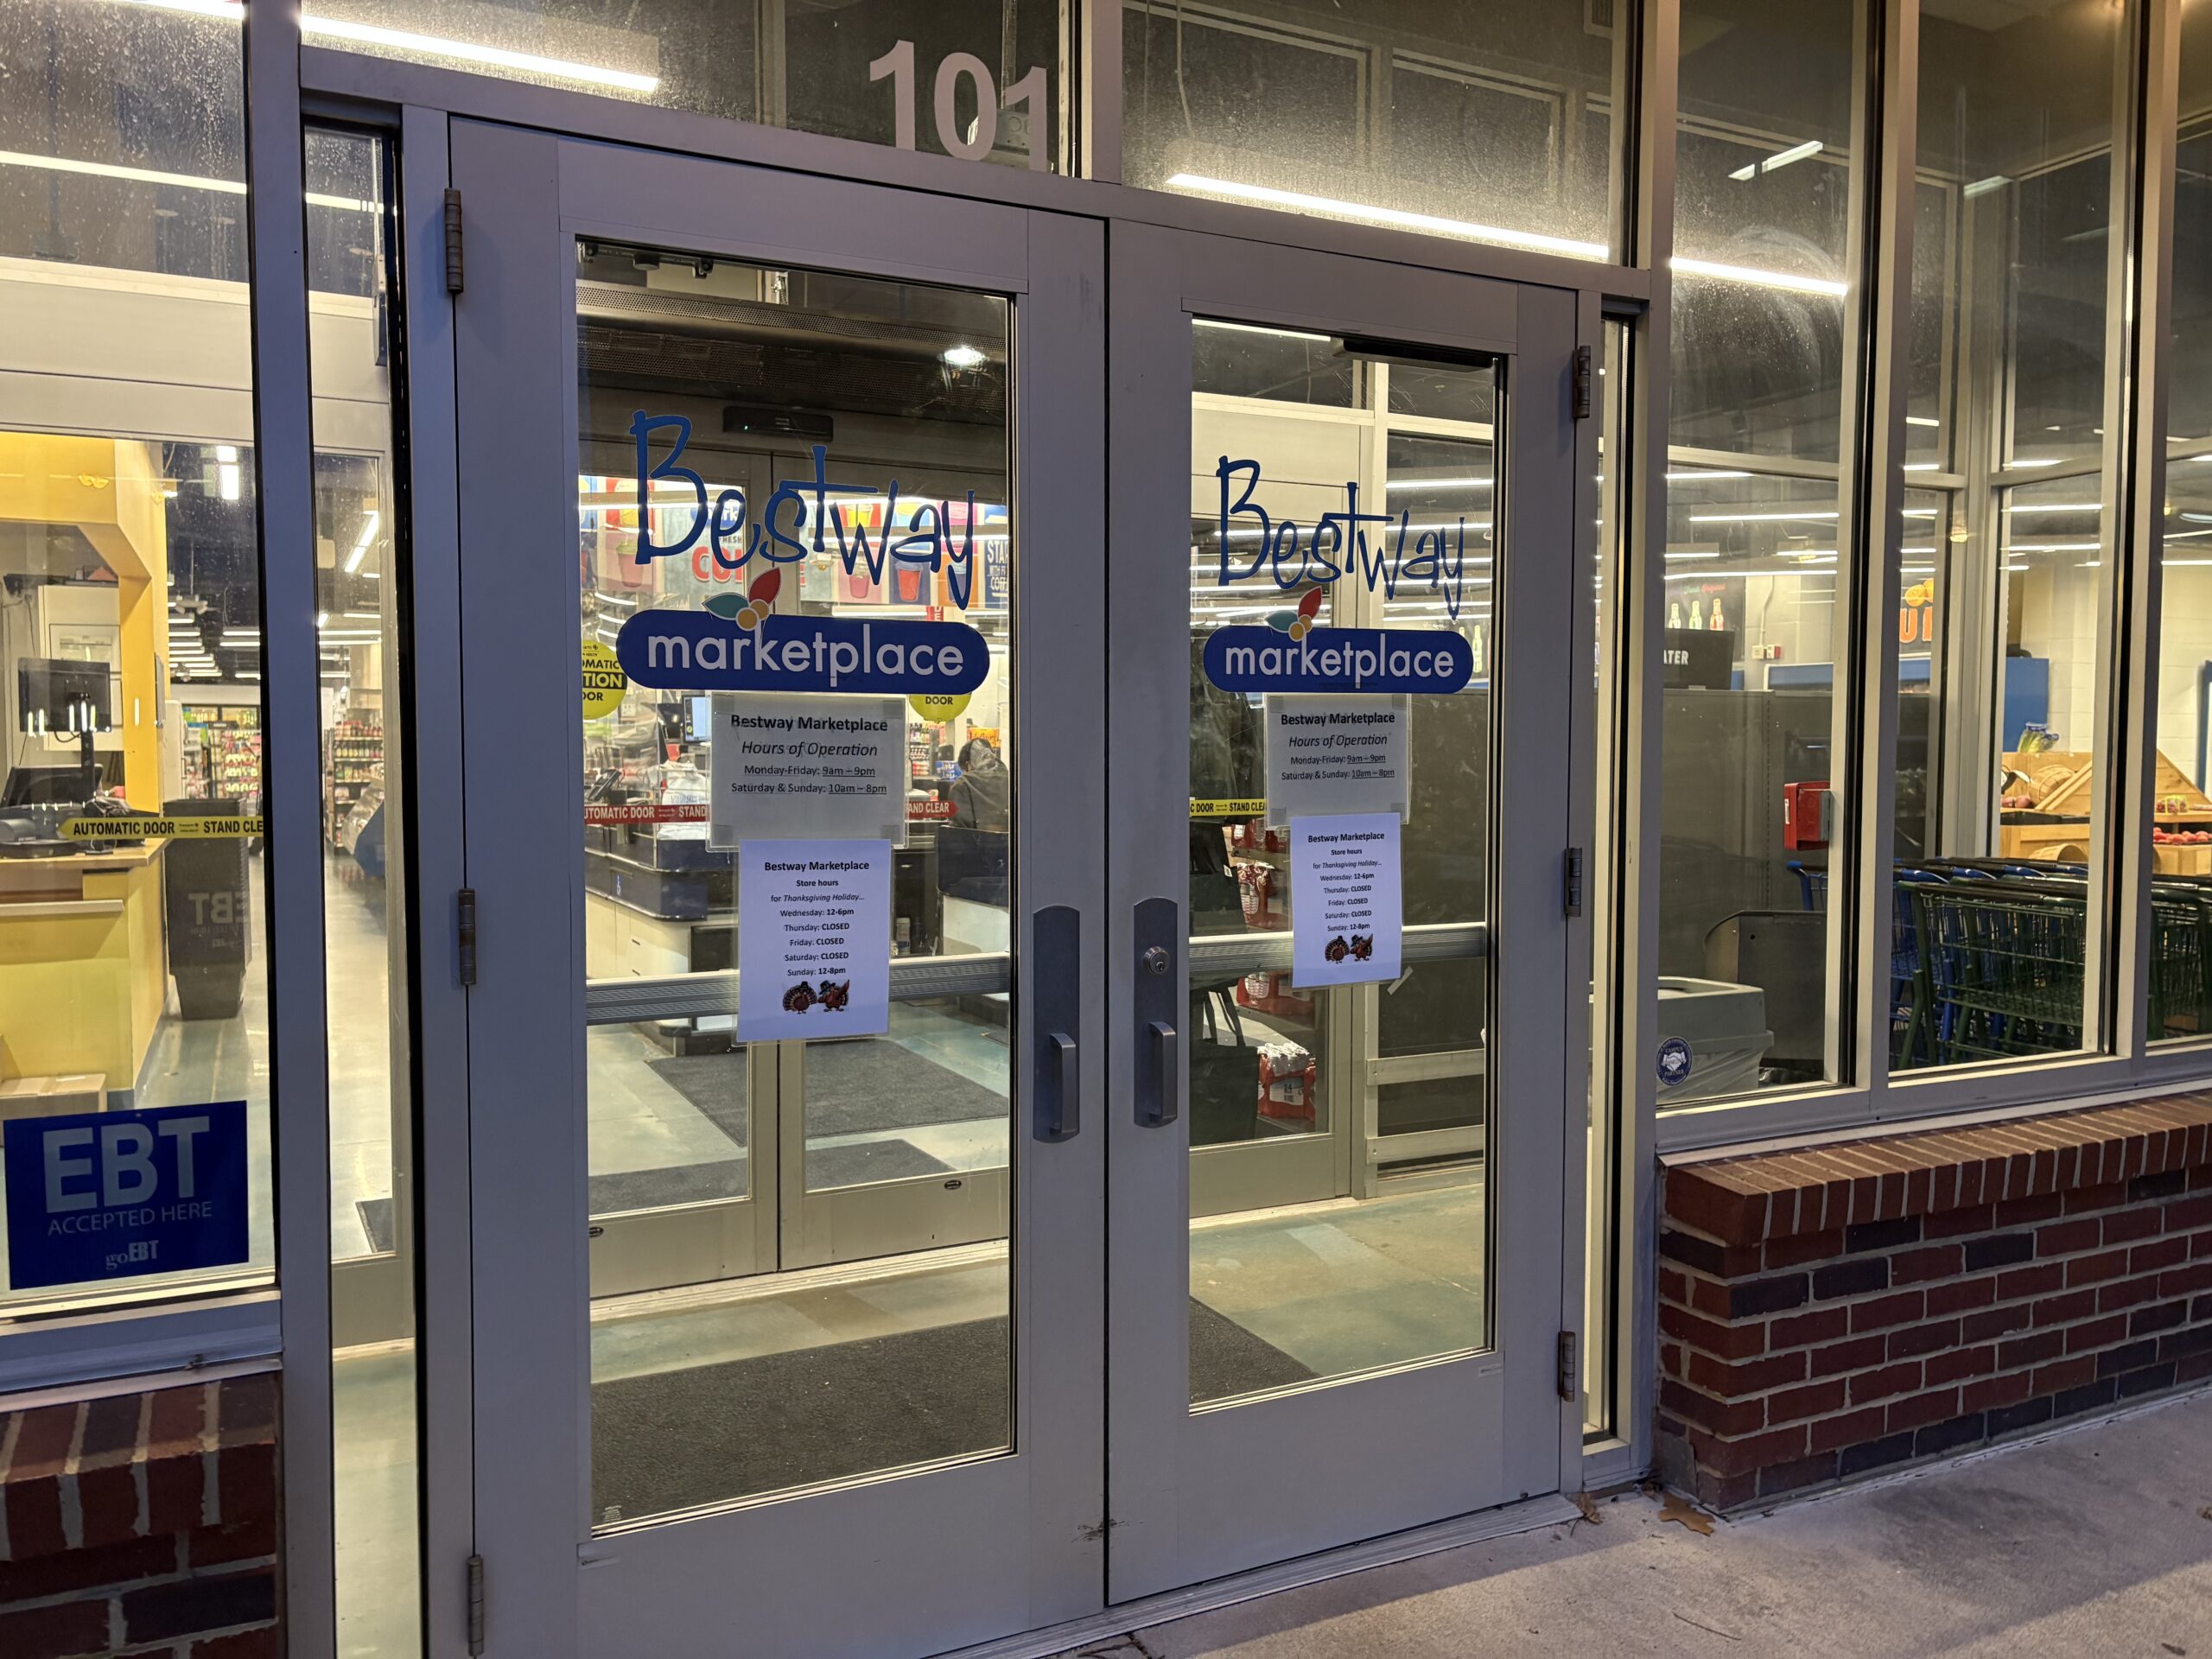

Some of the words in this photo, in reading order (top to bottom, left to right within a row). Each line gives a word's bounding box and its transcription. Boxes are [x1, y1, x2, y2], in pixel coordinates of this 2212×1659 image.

[869, 40, 1048, 173] 101
[629, 409, 975, 612] Bestway
[1215, 454, 1465, 621] Bestway
[647, 623, 964, 688] marketplace
[1225, 632, 1454, 690] marketplace
[925, 696, 953, 705] DOOR
[731, 715, 793, 732] Bestway
[798, 716, 888, 733] Marketplace
[1281, 713, 1326, 727] Bestway
[1329, 712, 1395, 726] Marketplace
[1289, 736, 1320, 747] Hours
[1323, 734, 1335, 748] of
[1336, 734, 1388, 748] Operation
[741, 741, 785, 754] Hours
[788, 741, 805, 757] of
[807, 742, 878, 758] Operation
[1290, 755, 1346, 766] Monday-Friday:
[1347, 754, 1363, 763] 9am
[1370, 754, 1386, 763] 9pm
[744, 765, 821, 777] Monday-Friday:
[822, 766, 843, 776] 9am
[854, 766, 875, 777] 9pm
[1281, 770, 1313, 780] Saturday
[1322, 770, 1350, 779] Sunday:
[1351, 769, 1371, 779] 10am
[1378, 768, 1395, 778] 8pm
[731, 783, 775, 794] Saturday
[778, 784, 785, 792] &
[788, 784, 826, 794] Sunday:
[828, 784, 855, 794] 10am
[866, 784, 887, 795] 8pm
[630, 806, 655, 818] DOOR
[678, 805, 706, 817] STAND
[925, 802, 950, 813] CLEAR
[1196, 803, 1214, 812] DOOR
[1229, 802, 1250, 811] STAND
[73, 822, 141, 836] AUTOMATIC
[143, 821, 175, 835] DOOR
[203, 820, 240, 834] STAND
[1307, 835, 1338, 843] Bestway
[1340, 832, 1385, 842] Marketplace
[764, 861, 806, 873] Bestway
[809, 861, 870, 872] Marketplace
[784, 893, 830, 903] Thanksgiving
[826, 908, 855, 917] 12-6pm
[785, 924, 820, 932] Thursday:
[790, 938, 814, 947] Friday:
[785, 953, 819, 962] Saturday:
[821, 951, 849, 960] CLOSED
[818, 967, 846, 976] 12-8pm
[43, 1116, 210, 1213] EBT
[48, 1208, 156, 1236] ACCEPTED
[162, 1201, 213, 1221] HERE
[105, 1240, 159, 1271] goEBT
